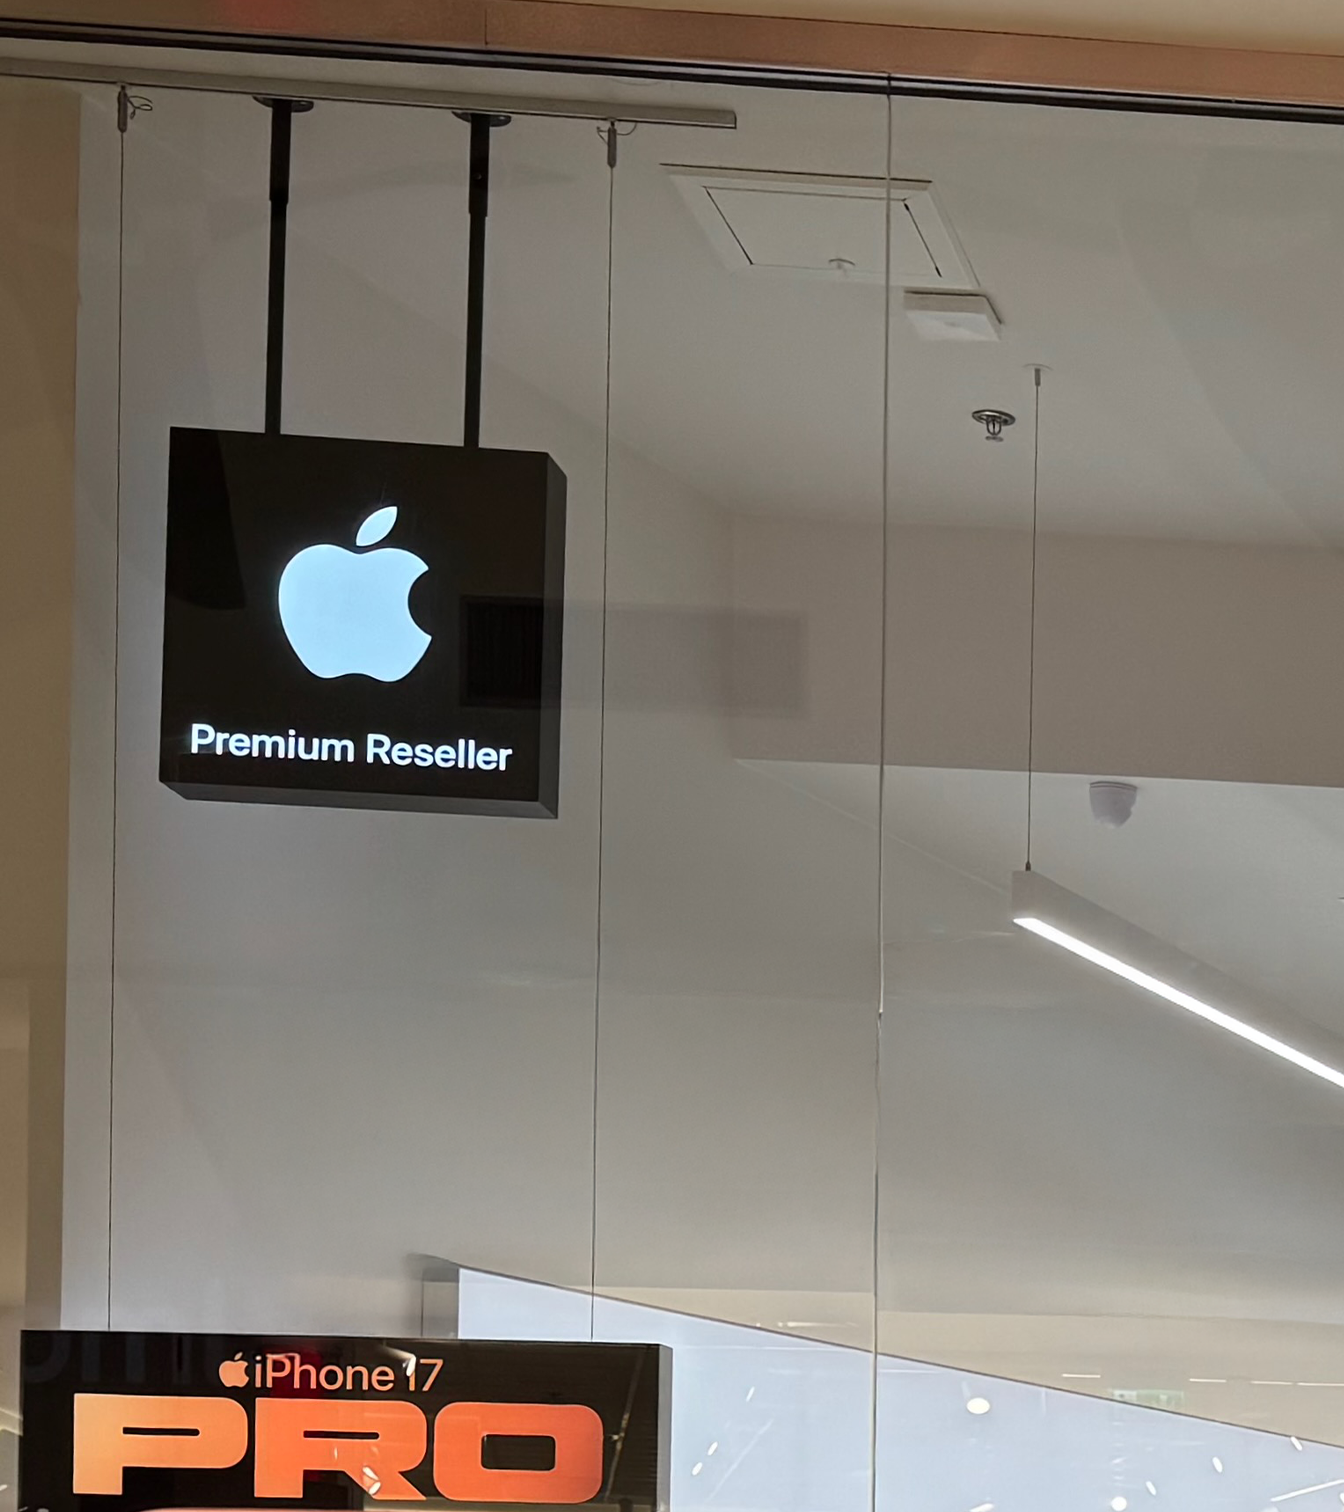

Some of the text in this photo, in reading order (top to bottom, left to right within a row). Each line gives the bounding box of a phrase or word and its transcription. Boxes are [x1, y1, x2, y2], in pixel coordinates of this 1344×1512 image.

[190, 722, 513, 771] Premium Reseller
[254, 1352, 444, 1392] iPhone 17
[73, 1393, 604, 1504] PRO
